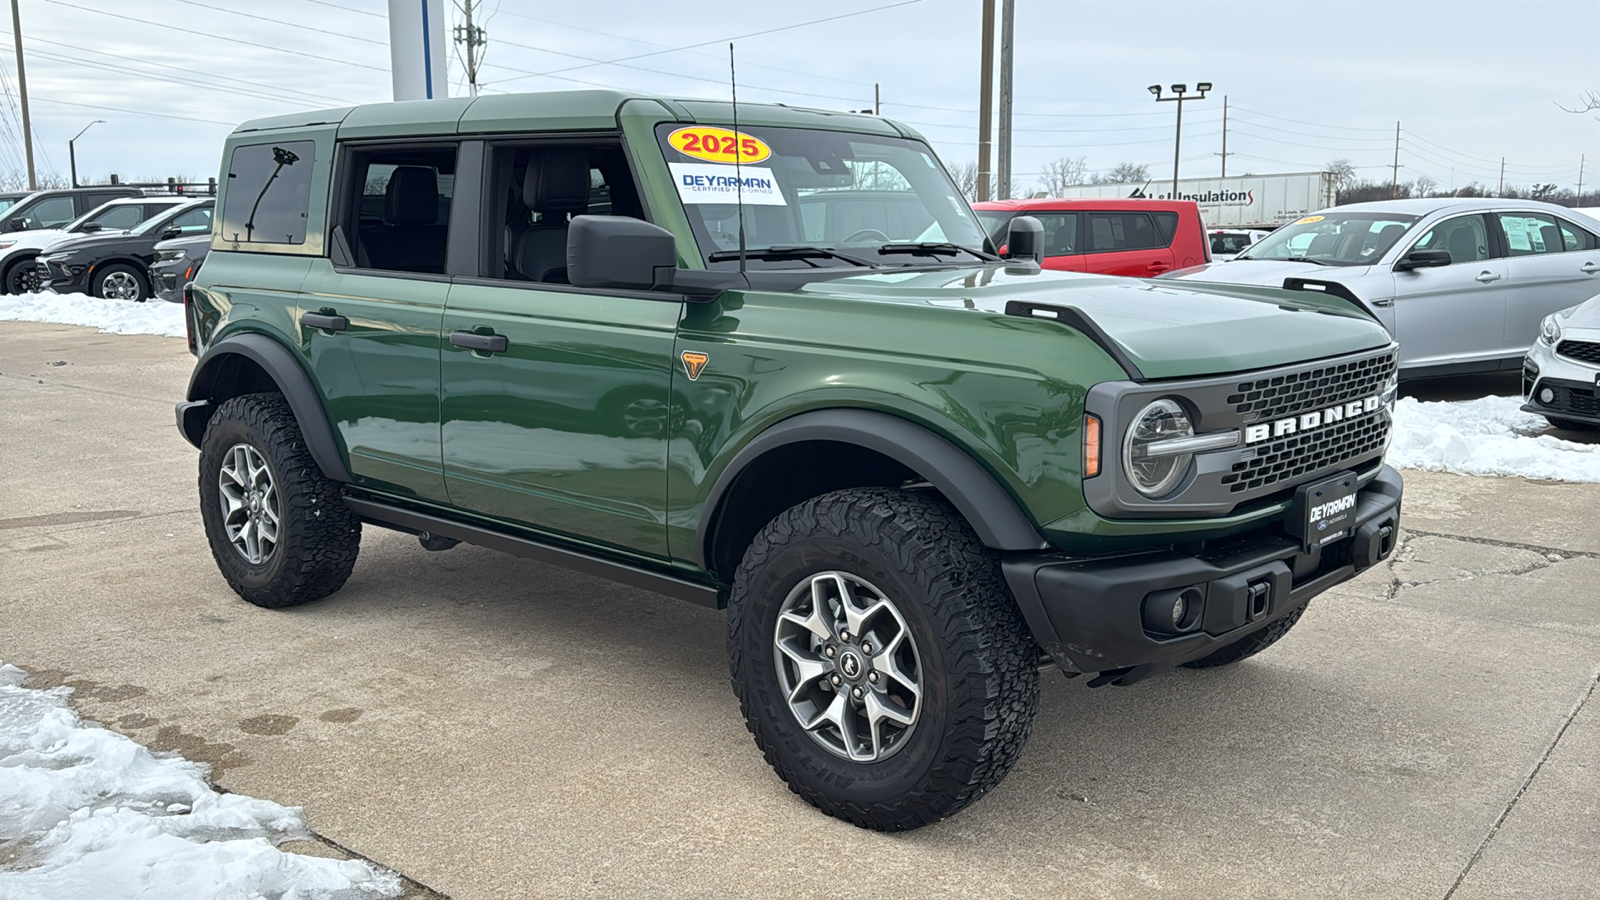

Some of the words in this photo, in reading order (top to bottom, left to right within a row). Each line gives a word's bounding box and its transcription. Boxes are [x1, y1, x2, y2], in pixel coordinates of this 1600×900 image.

[682, 133, 760, 157] 2025
[683, 175, 771, 188] DEYARMAN
[1245, 396, 1379, 444] BRONCO
[1310, 493, 1356, 523] DEYARMAN
